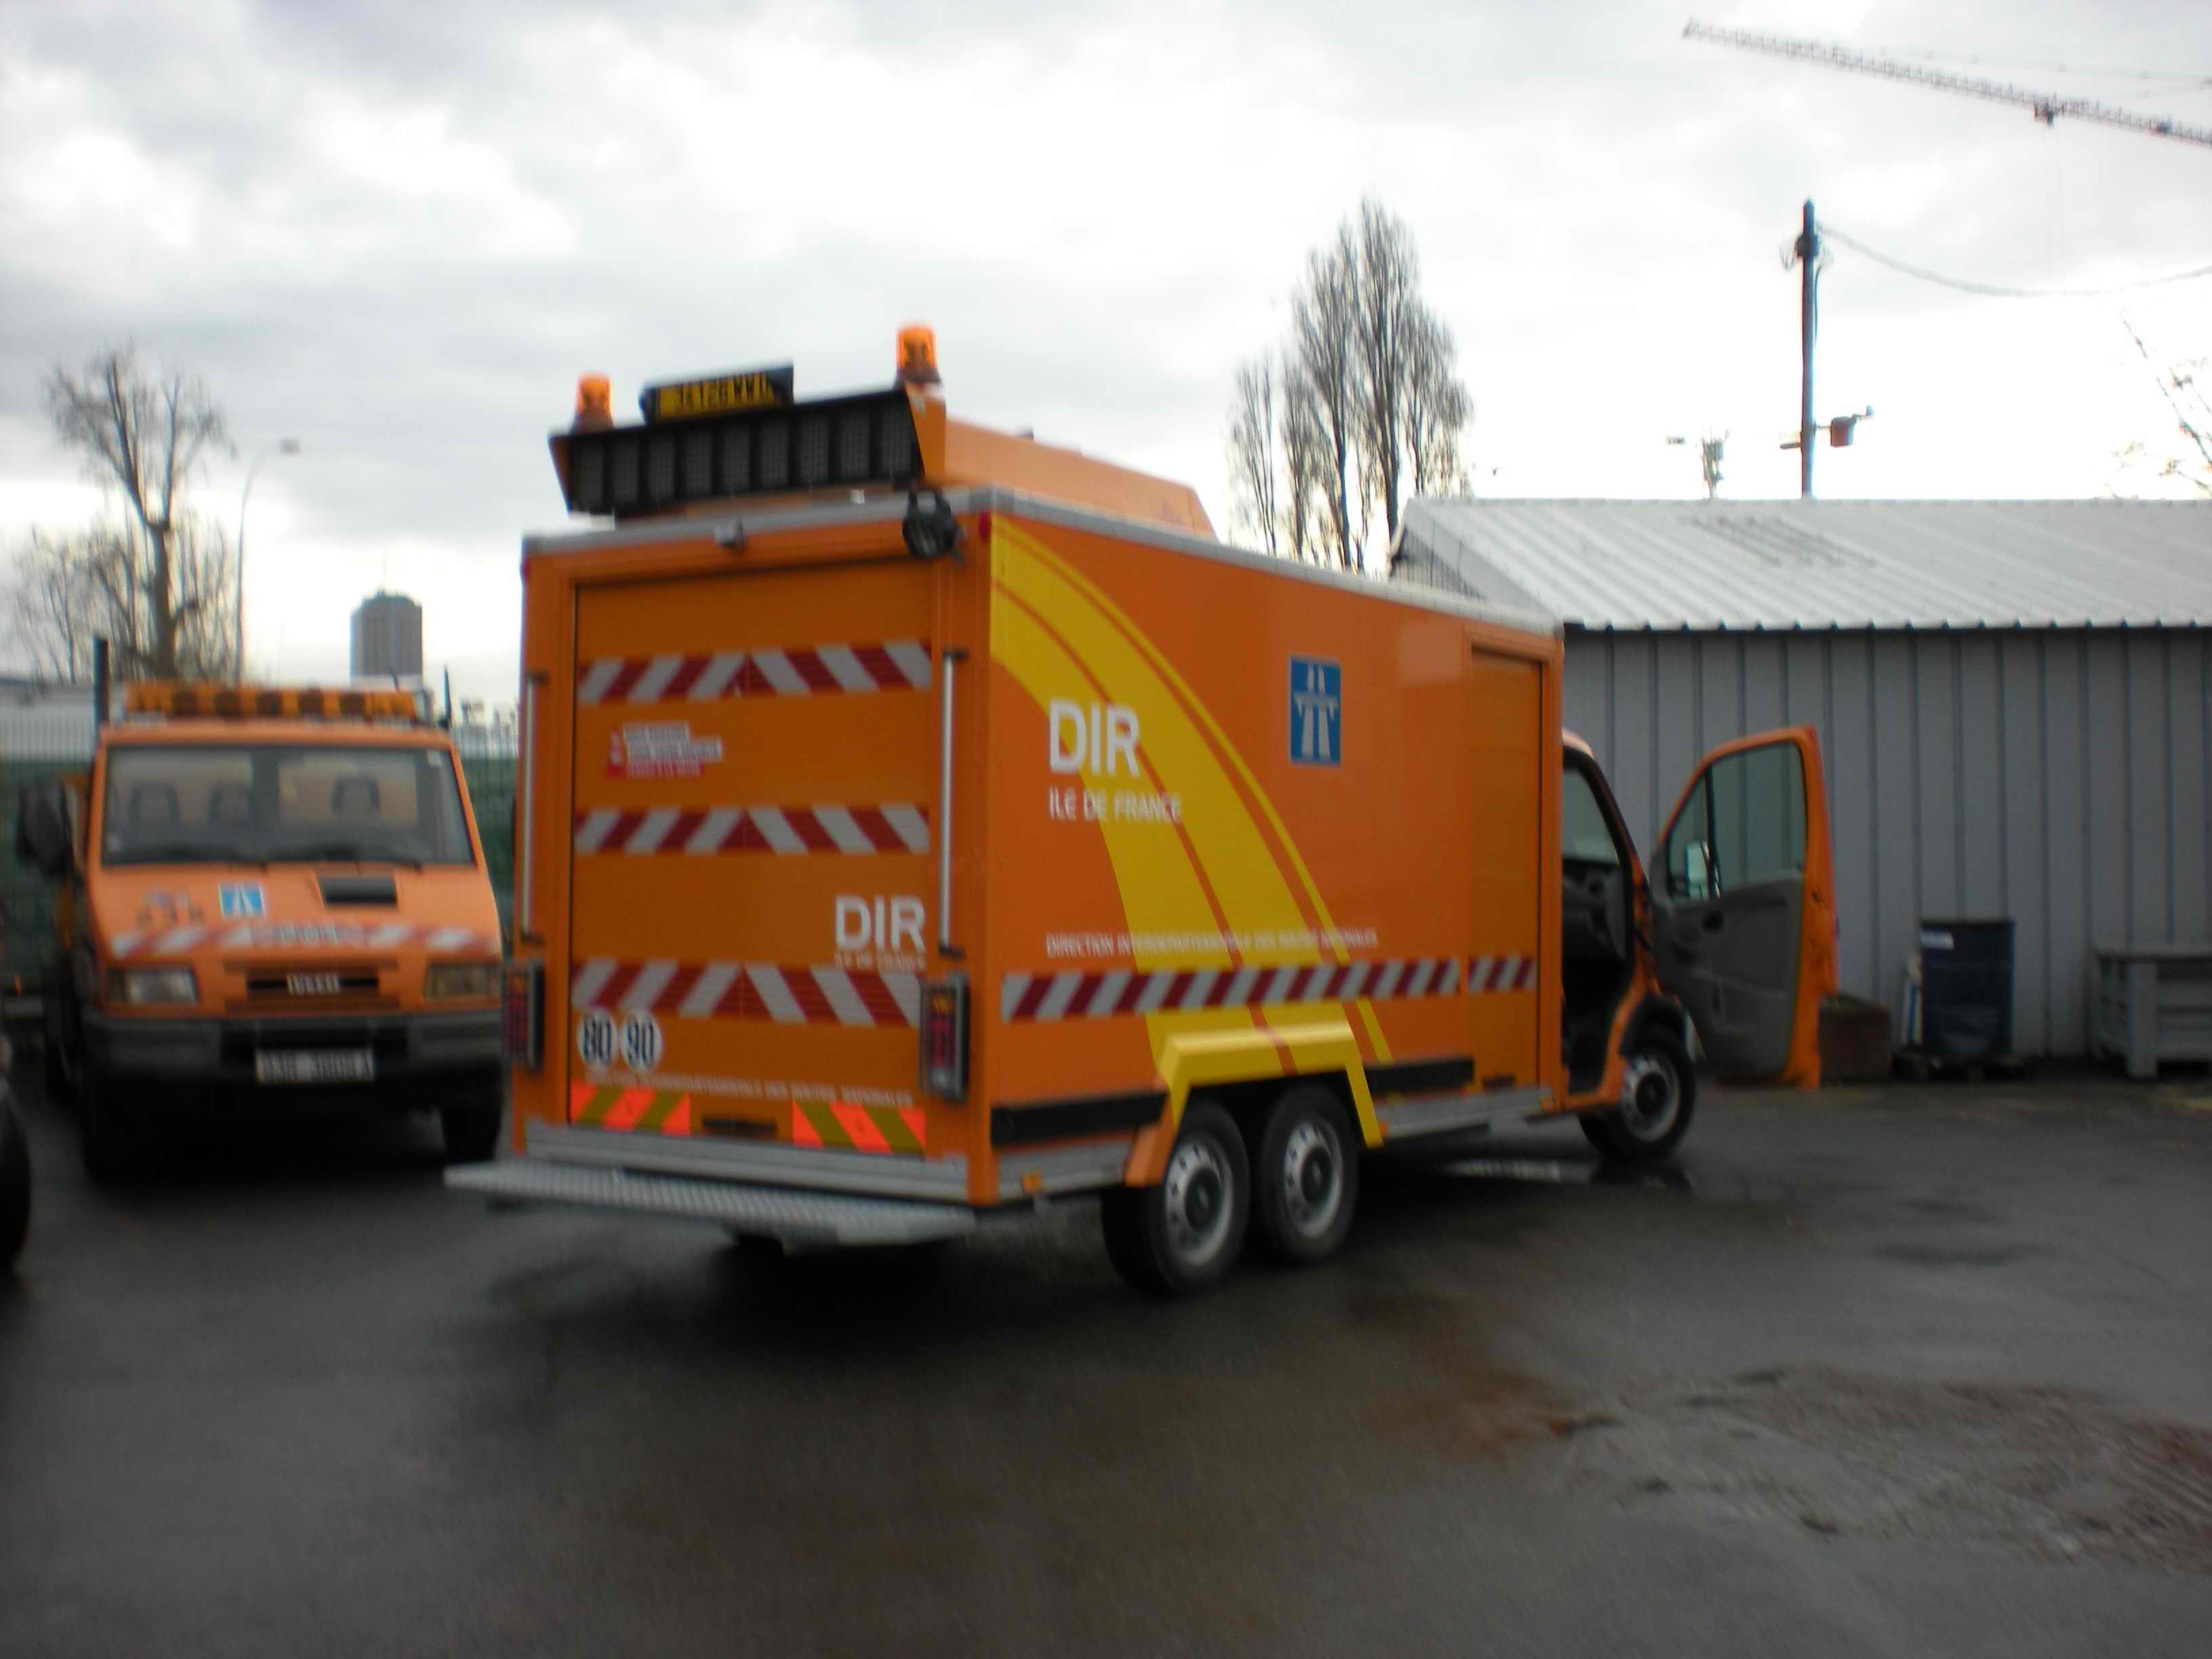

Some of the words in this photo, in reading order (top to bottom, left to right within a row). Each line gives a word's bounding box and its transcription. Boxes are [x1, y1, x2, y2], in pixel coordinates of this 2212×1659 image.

[1048, 700, 1140, 779] DIR
[1049, 786, 1078, 820] ILE
[1082, 787, 1107, 823] DE
[1113, 790, 1183, 825] FRANCE
[835, 895, 926, 954] DIR
[626, 1017, 655, 1067] 90
